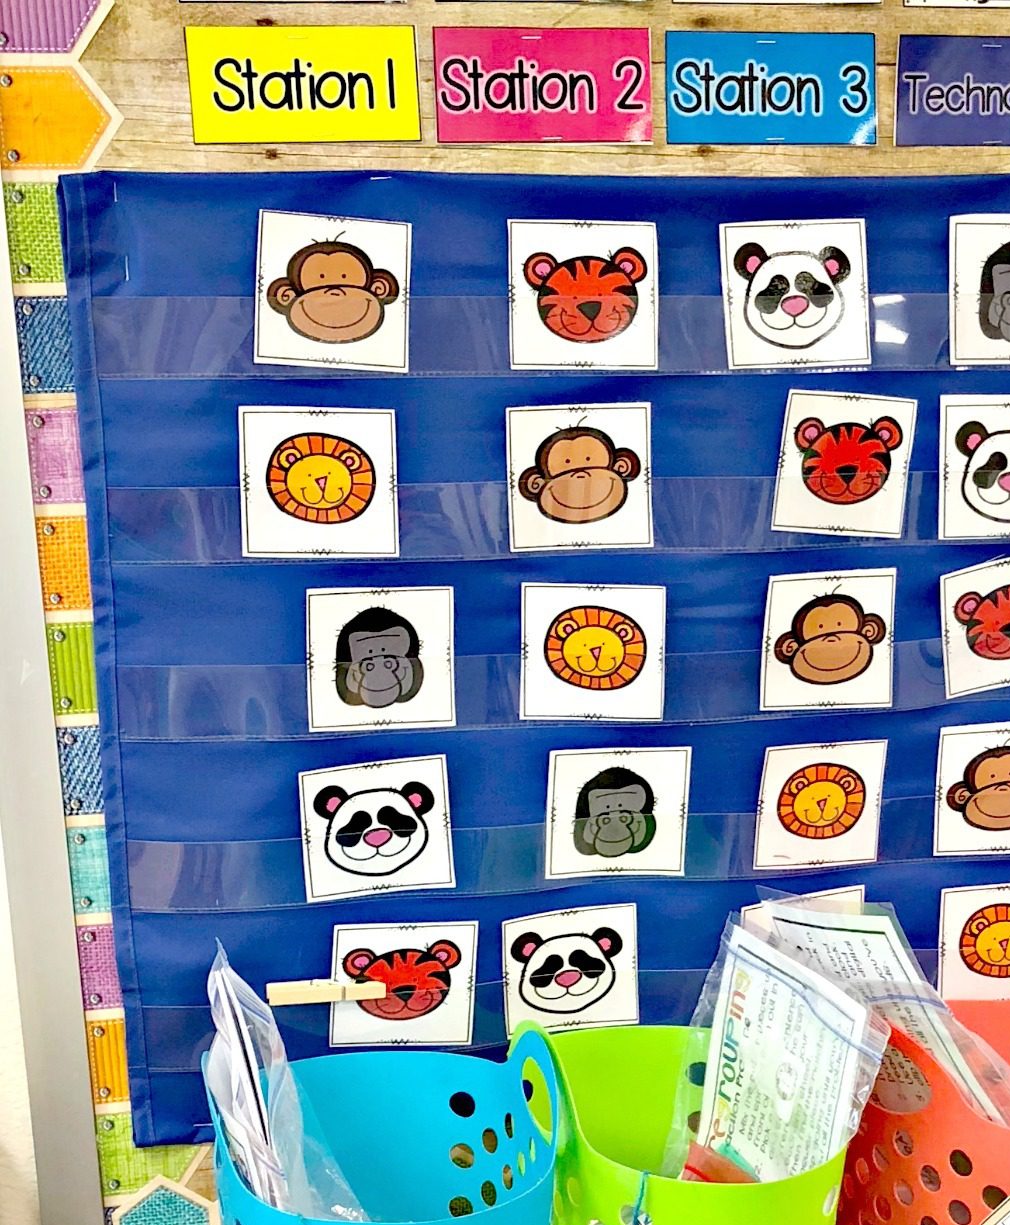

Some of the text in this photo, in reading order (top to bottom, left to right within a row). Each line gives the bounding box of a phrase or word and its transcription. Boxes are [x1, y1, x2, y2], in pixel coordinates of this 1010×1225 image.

[213, 57, 397, 112] Station 1
[440, 57, 647, 113] Station 2
[673, 60, 870, 119] Station 3
